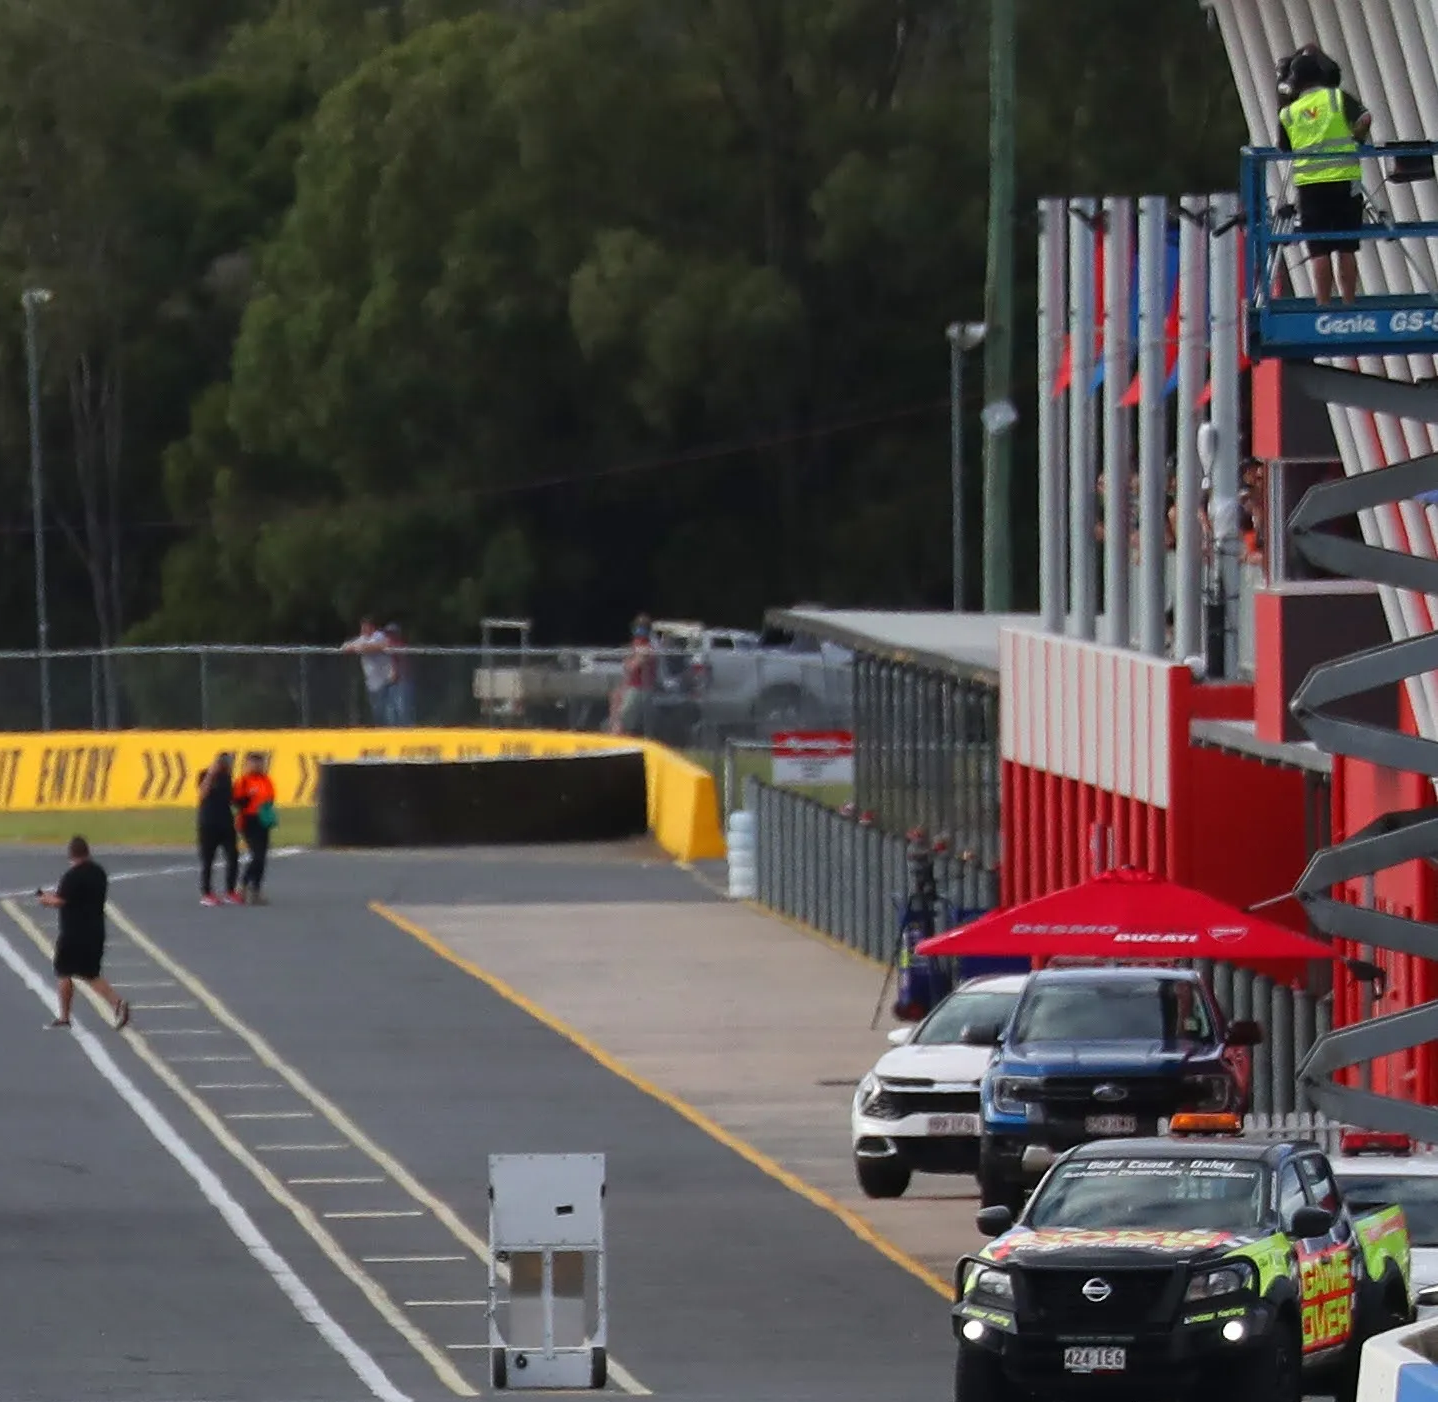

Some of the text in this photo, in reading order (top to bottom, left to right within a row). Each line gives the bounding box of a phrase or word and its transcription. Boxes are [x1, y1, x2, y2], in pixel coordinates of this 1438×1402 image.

[35, 746, 117, 805] ENTRY
[1113, 933, 1199, 943] DUCATI
[1301, 1251, 1352, 1300] GAME
[1302, 1296, 1350, 1345] OVER
[1065, 1350, 1091, 1365] 424
